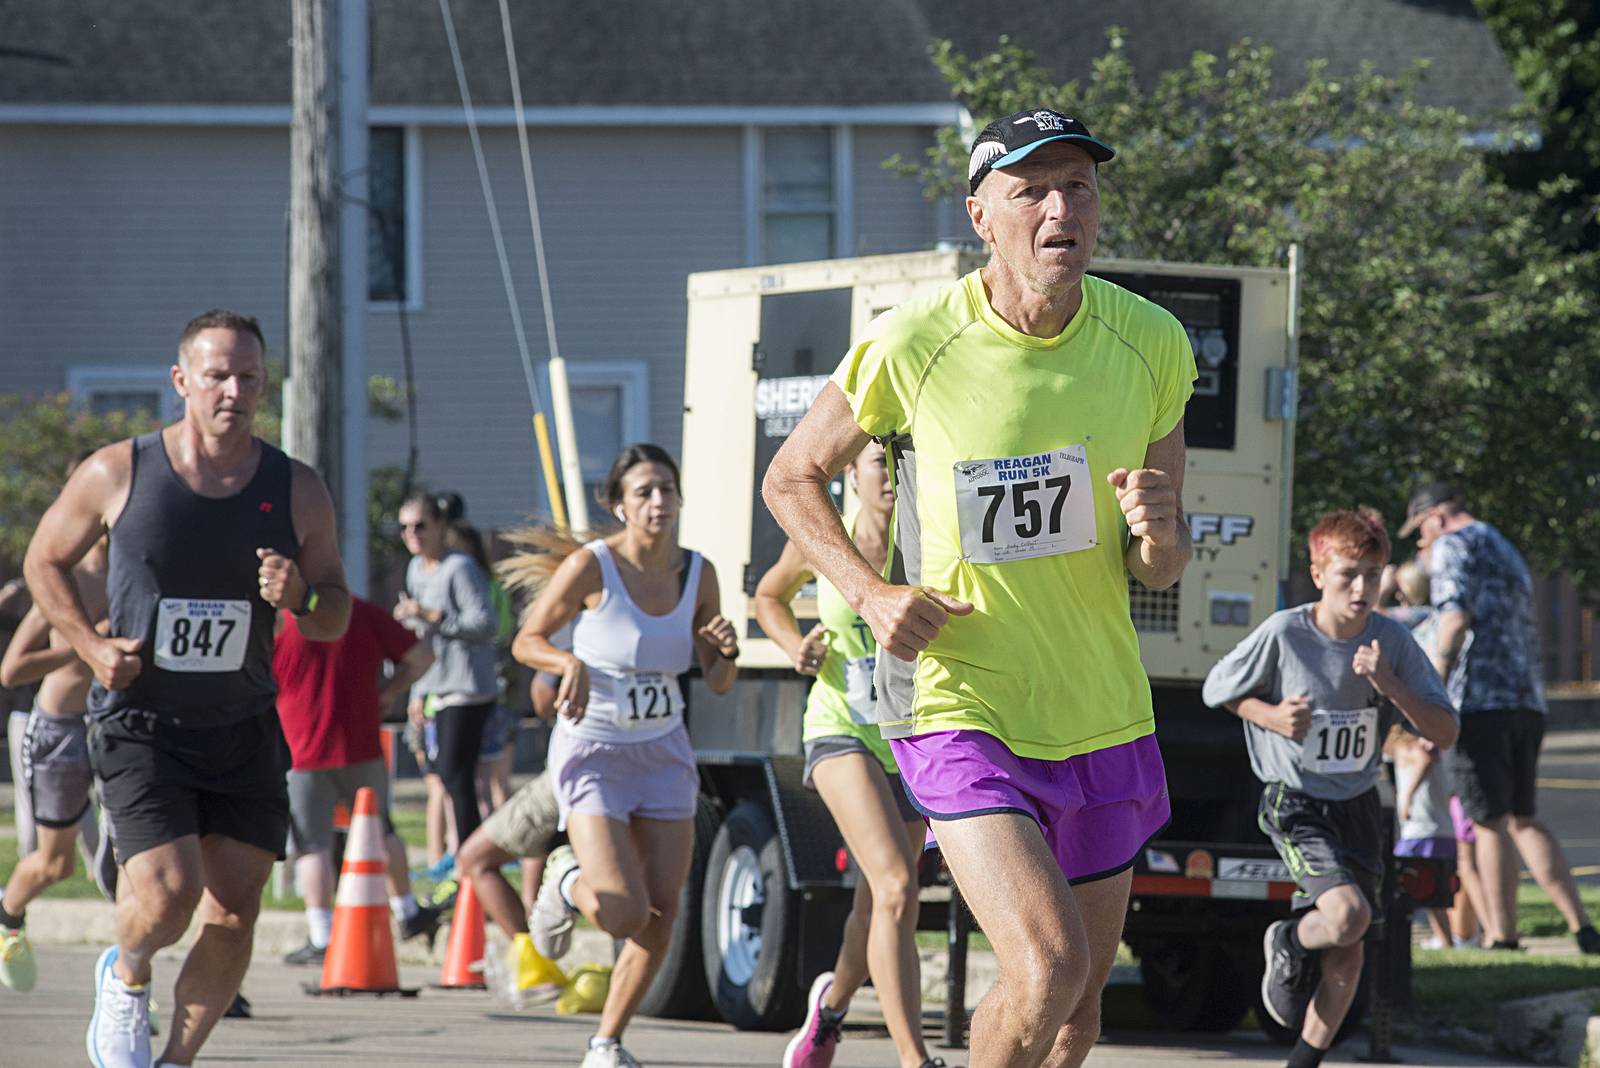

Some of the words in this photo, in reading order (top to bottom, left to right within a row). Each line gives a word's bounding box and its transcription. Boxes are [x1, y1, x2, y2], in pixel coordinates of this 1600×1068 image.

[755, 375, 832, 418] SHER
[994, 454, 1052, 470] REAGAN
[998, 468, 1028, 481] RUN
[1032, 465, 1051, 478] 5K
[977, 475, 1072, 543] 757
[171, 618, 236, 657] 847
[627, 685, 672, 720] 121
[1316, 725, 1367, 761] 106
